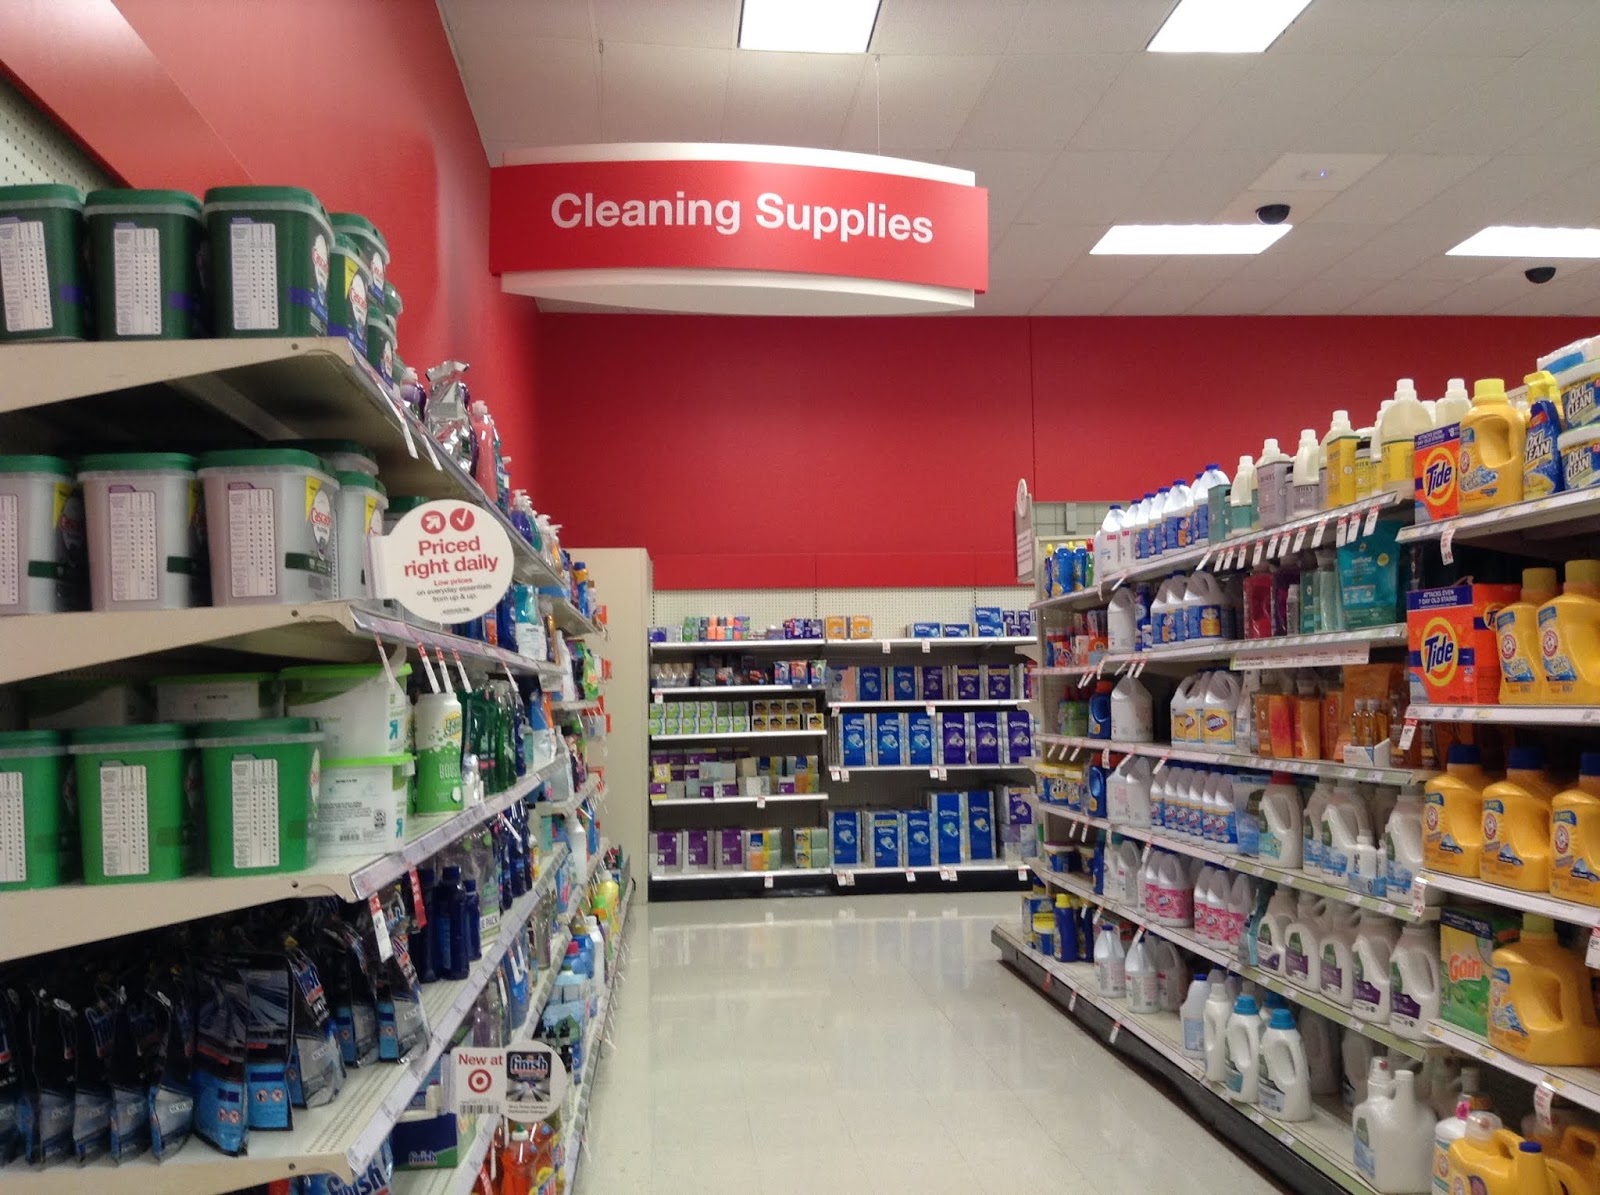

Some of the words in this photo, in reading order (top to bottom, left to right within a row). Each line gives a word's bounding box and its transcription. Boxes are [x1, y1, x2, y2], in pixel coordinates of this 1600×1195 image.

[551, 191, 740, 236] Cleaning
[755, 192, 933, 244] Supplies
[1567, 394, 1592, 419] CLEAN
[1570, 386, 1587, 405] OXI
[1525, 438, 1551, 464] LEAN
[1569, 449, 1585, 466] OXI
[1427, 461, 1452, 497] Tide
[1567, 455, 1590, 481] CLEAN
[418, 535, 481, 556] Priced
[404, 558, 450, 580] right
[455, 554, 499, 574] daily
[1425, 635, 1453, 674] Tide
[1449, 952, 1482, 982] Gain
[459, 1054, 486, 1065] New
[491, 1055, 503, 1066] at
[511, 1054, 548, 1071] finish
